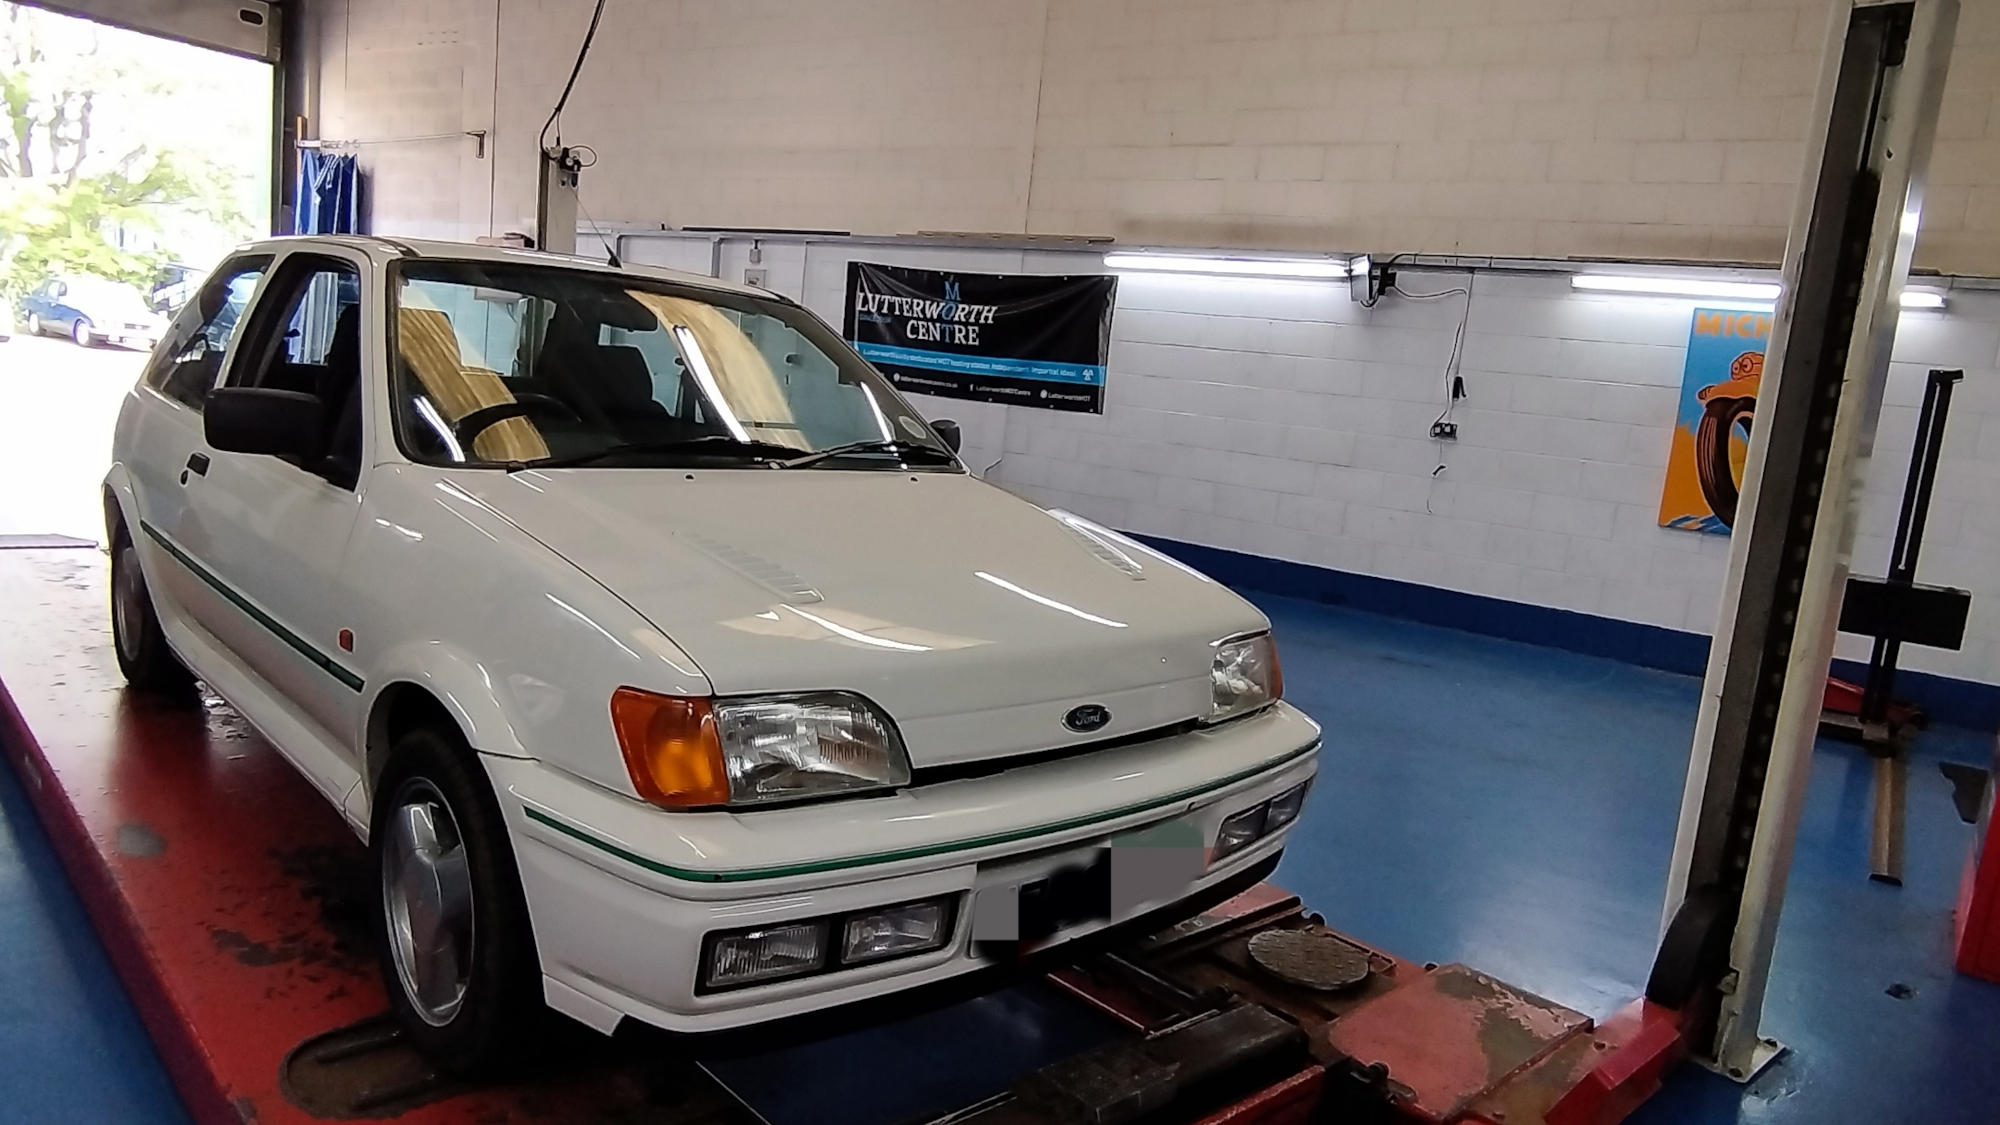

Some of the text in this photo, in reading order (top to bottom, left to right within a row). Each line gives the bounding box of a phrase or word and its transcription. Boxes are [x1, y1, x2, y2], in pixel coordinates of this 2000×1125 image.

[857, 292, 998, 324] LUTTERWORTH
[907, 319, 979, 345] CENTRE
[1075, 708, 1101, 725] Ford
